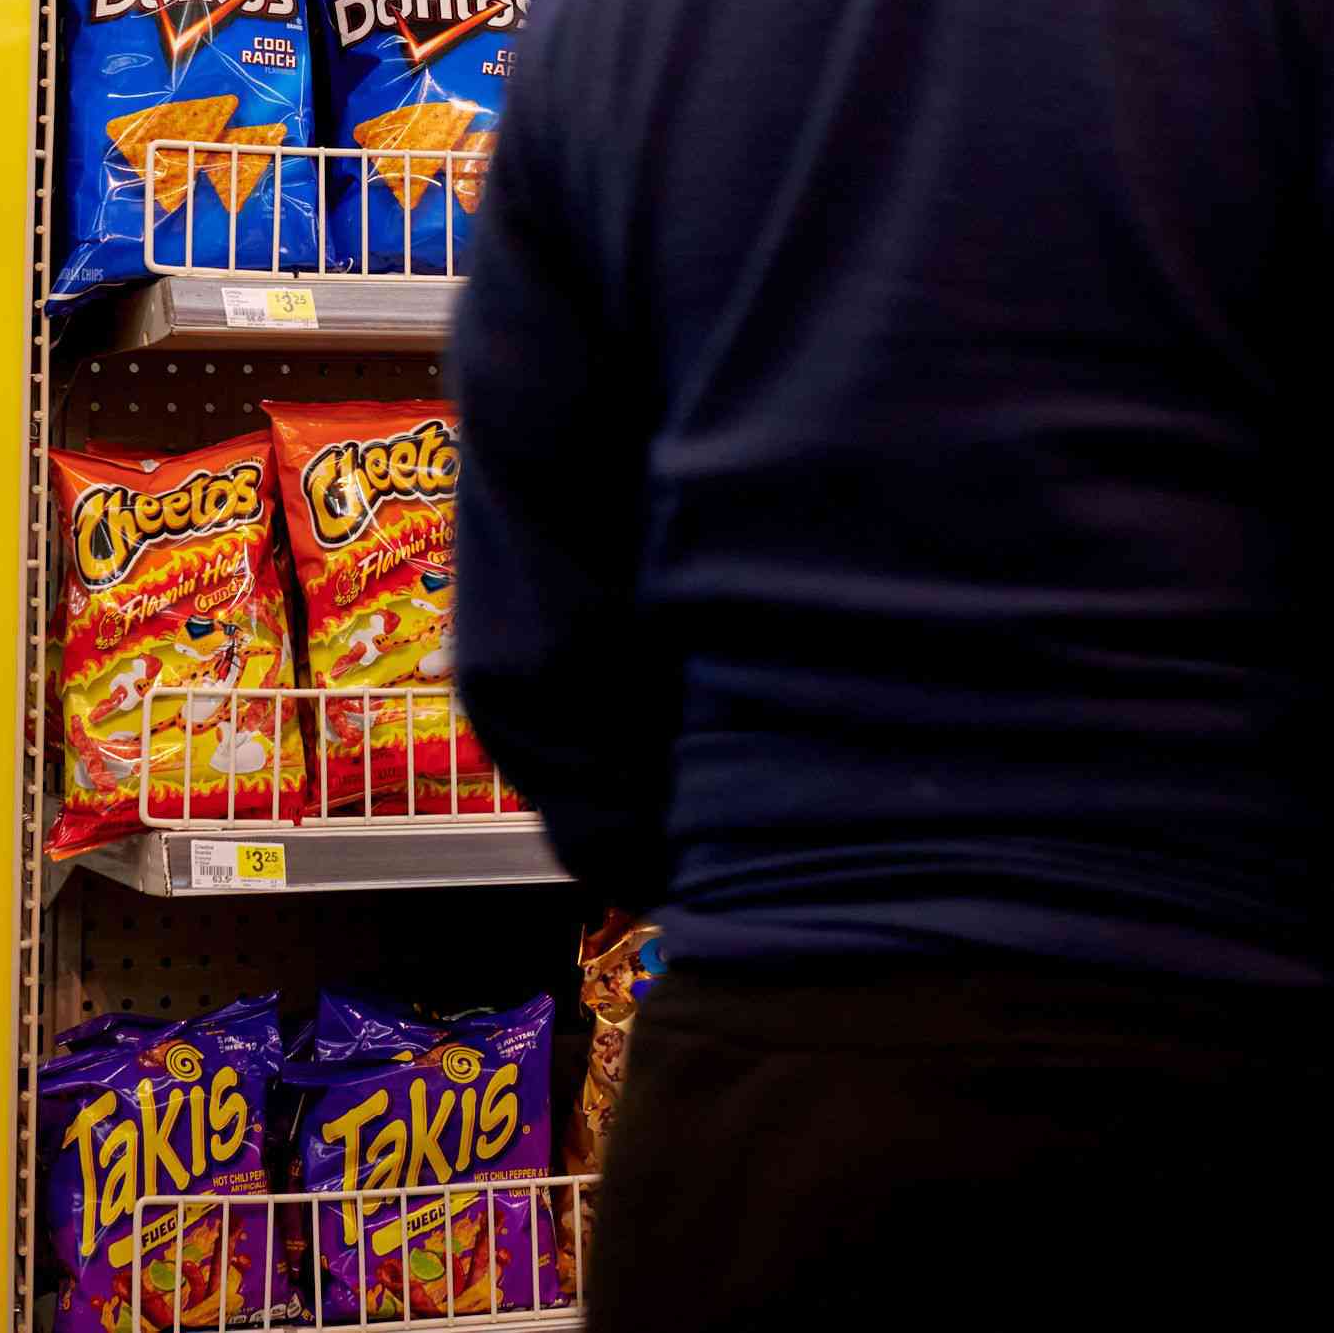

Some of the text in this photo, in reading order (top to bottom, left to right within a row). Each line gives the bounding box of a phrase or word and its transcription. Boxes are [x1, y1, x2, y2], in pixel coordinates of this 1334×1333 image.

[253, 36, 295, 52] COOL
[241, 49, 297, 69] RANCH
[307, 424, 460, 538] Cheeto
[76, 467, 259, 581] Cheetos
[430, 525, 454, 547] Ho
[61, 1044, 248, 1257] Takis
[321, 1045, 518, 1246] Takis
[230, 1171, 249, 1184] CHILI
[490, 1170, 508, 1181] CHILI
[509, 1168, 537, 1180] PEPPER
